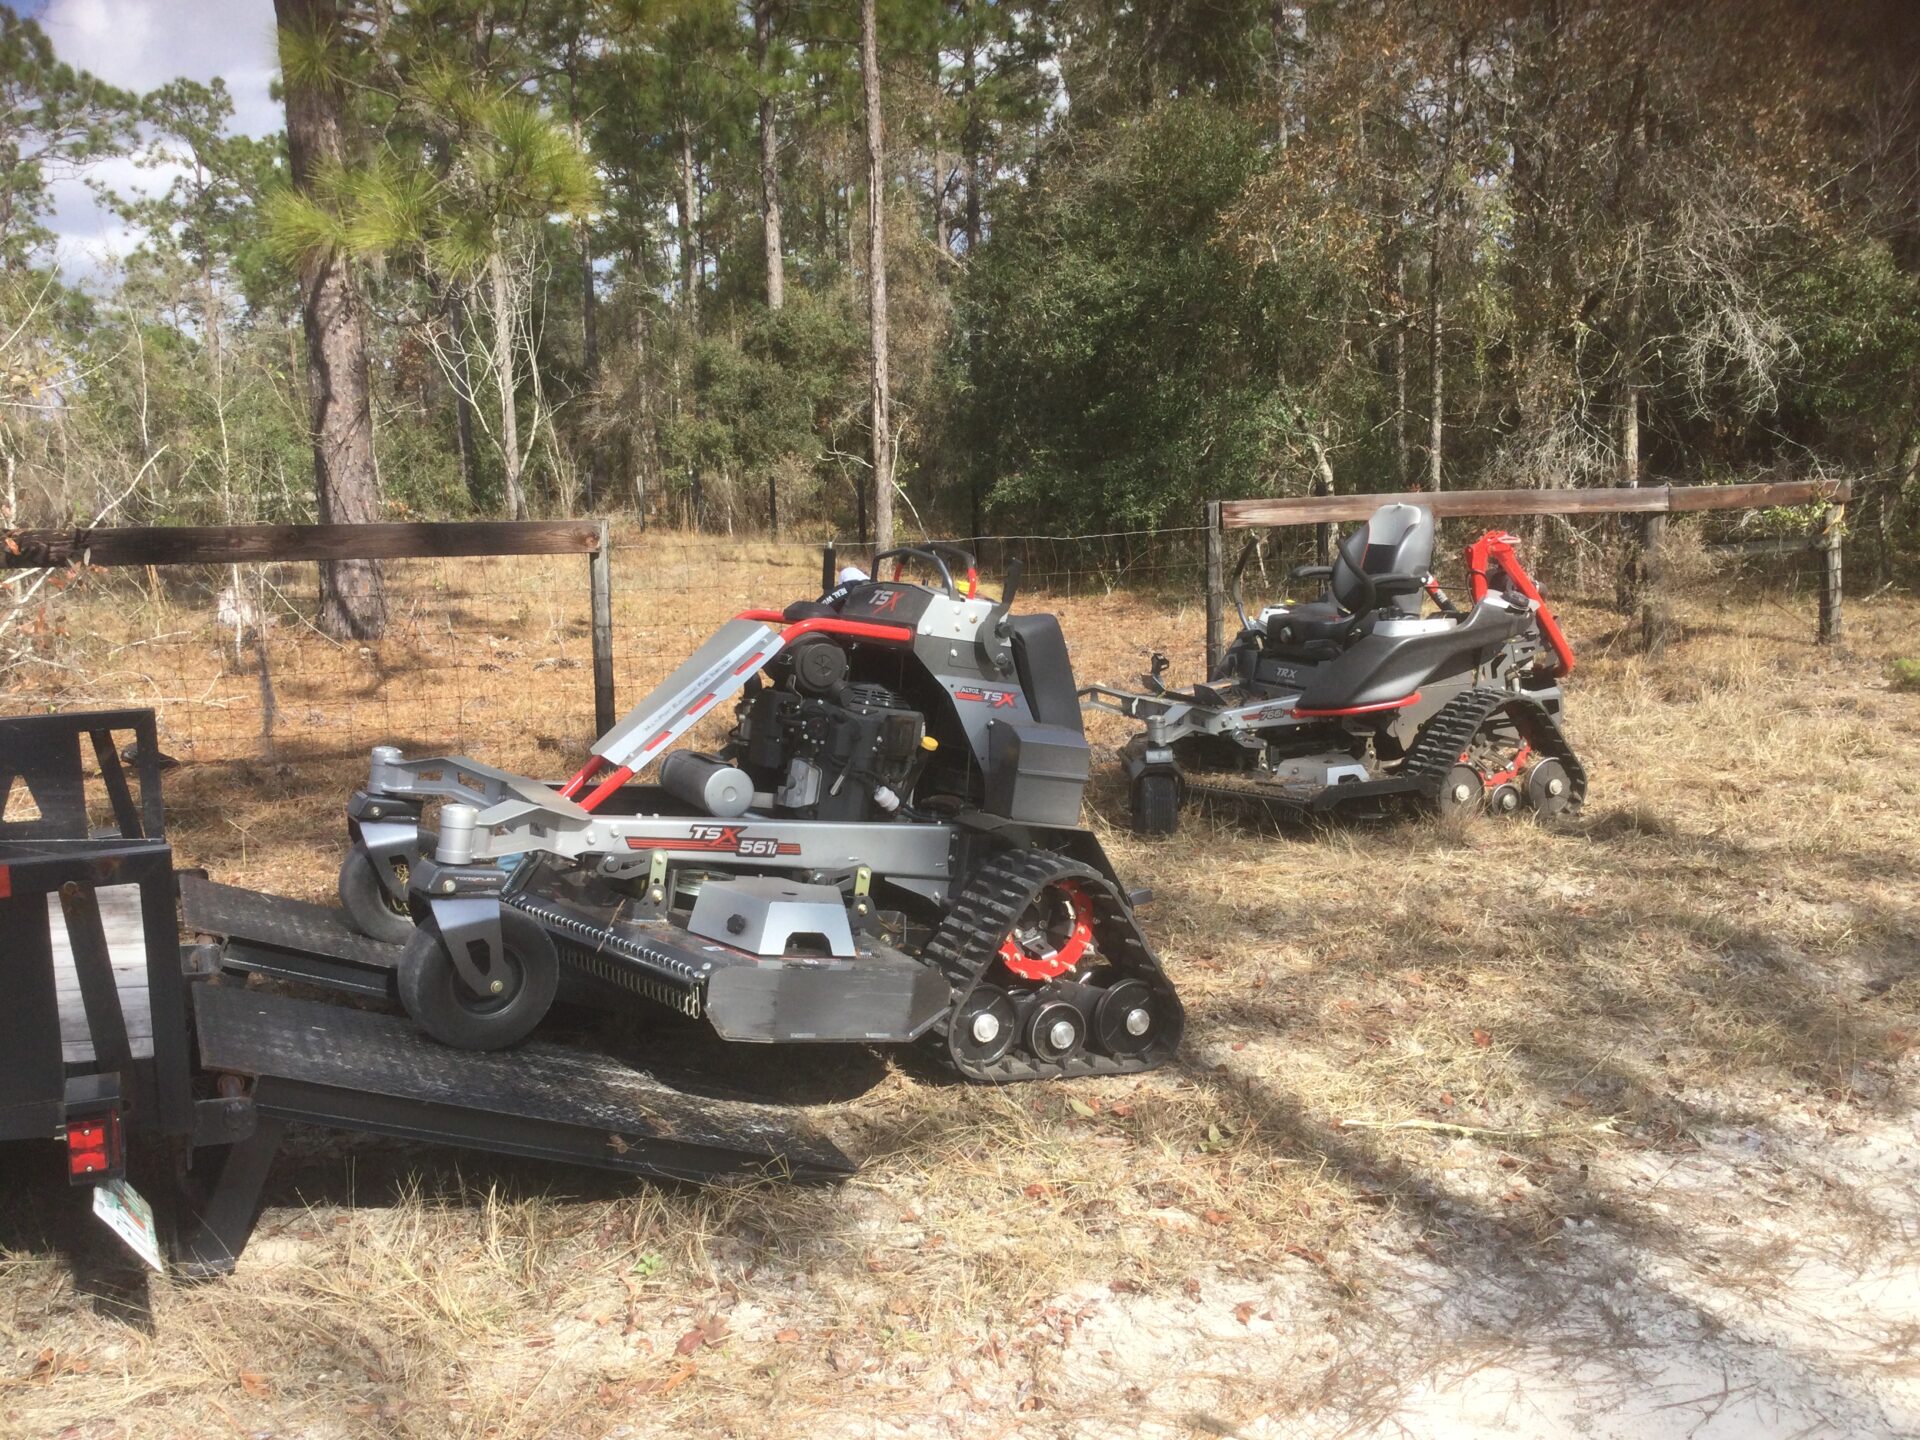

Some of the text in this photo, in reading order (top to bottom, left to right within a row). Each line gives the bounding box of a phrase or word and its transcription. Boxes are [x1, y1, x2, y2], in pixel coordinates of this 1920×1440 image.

[869, 589, 908, 615] TSX
[1276, 667, 1298, 678] TRX
[983, 690, 1018, 708] TSX
[693, 826, 746, 846] TSX
[739, 839, 777, 855] 561i
